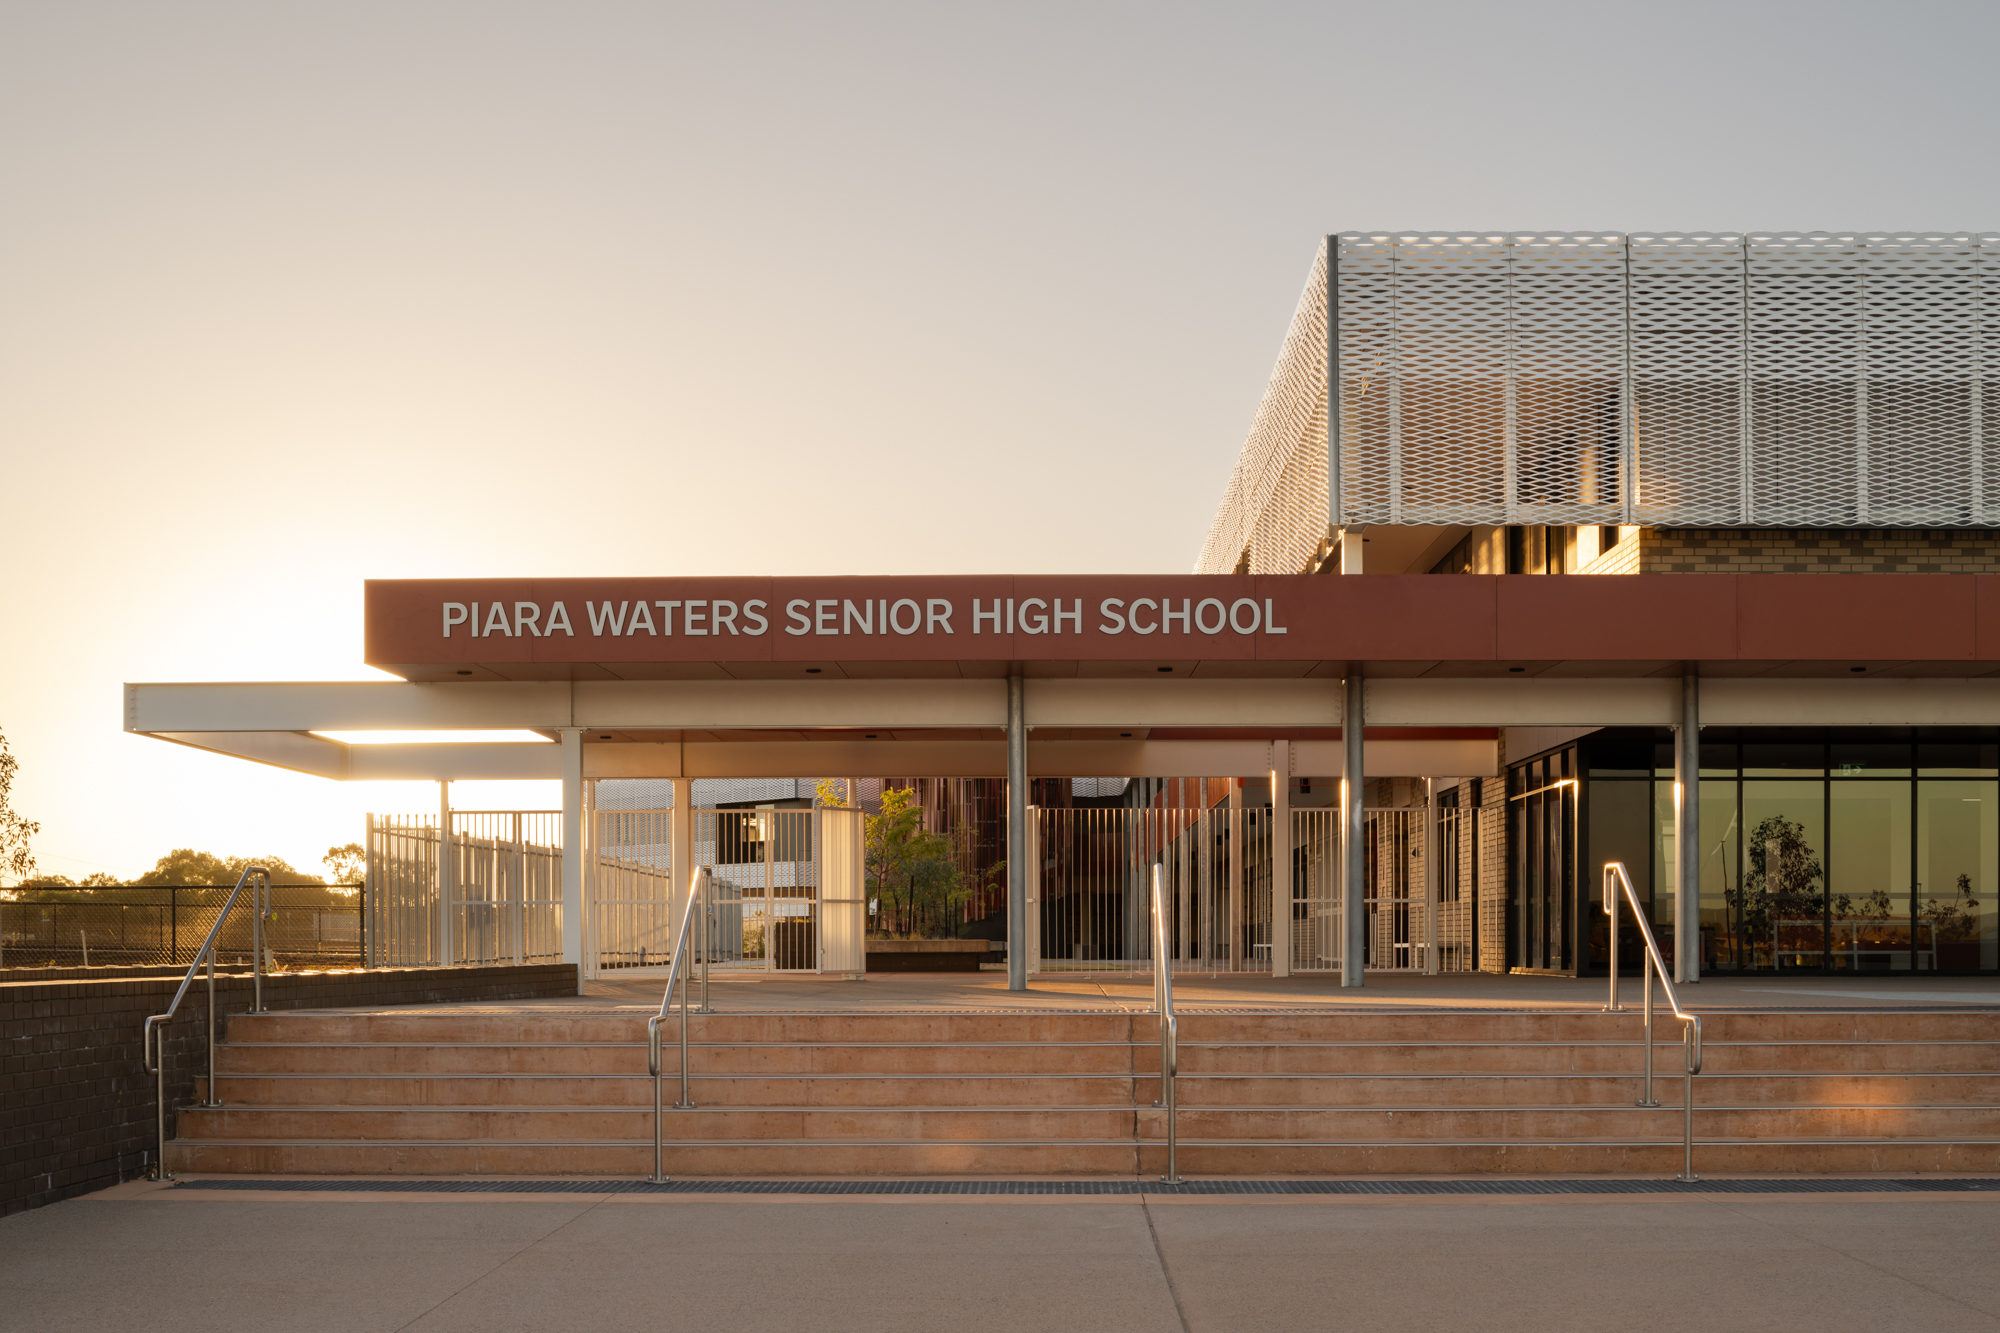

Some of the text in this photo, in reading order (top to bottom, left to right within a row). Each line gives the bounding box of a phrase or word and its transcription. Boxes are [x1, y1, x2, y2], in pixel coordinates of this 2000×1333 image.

[441, 596, 1288, 638] PIARA WATERS SENIOR HIGH SCHOOL
